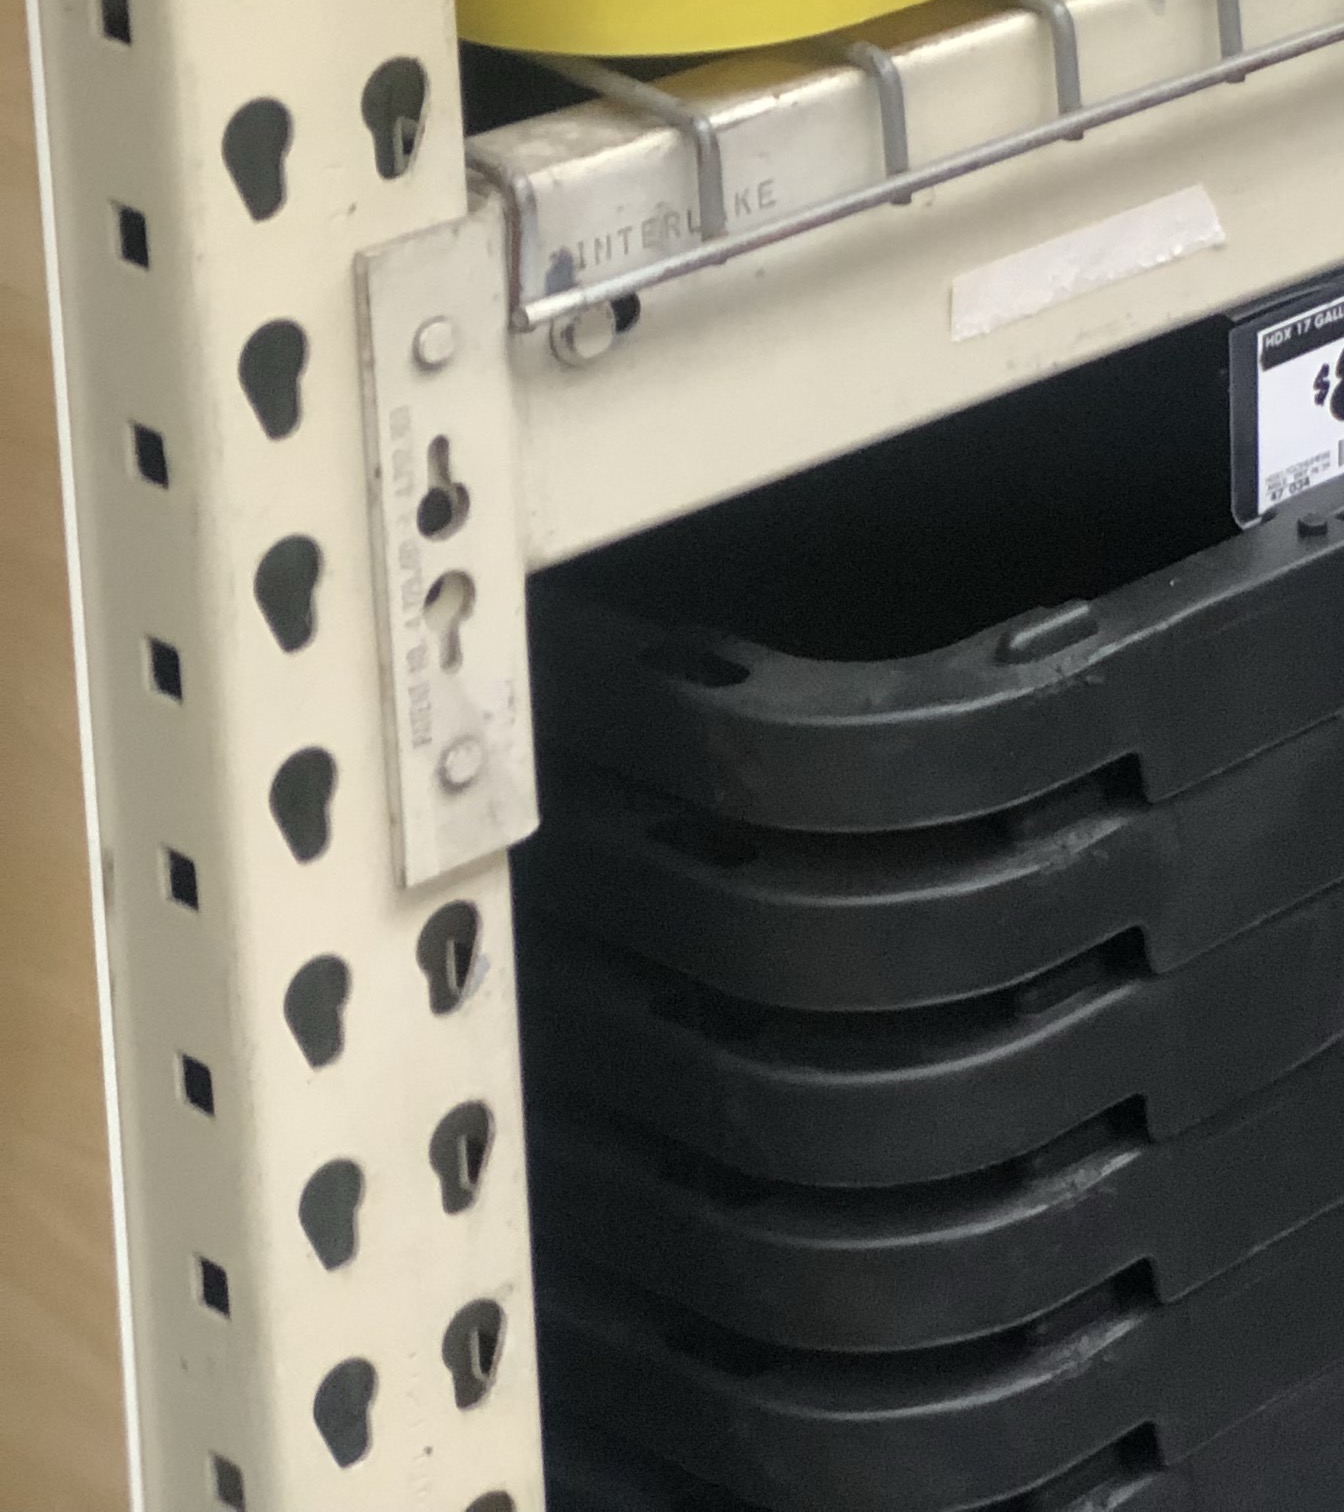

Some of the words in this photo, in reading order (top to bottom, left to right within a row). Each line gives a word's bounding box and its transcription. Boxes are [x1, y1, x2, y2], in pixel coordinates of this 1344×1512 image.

[574, 177, 779, 271] INTERLKE
[1264, 331, 1293, 349] HDX
[1297, 320, 1312, 338] 17
